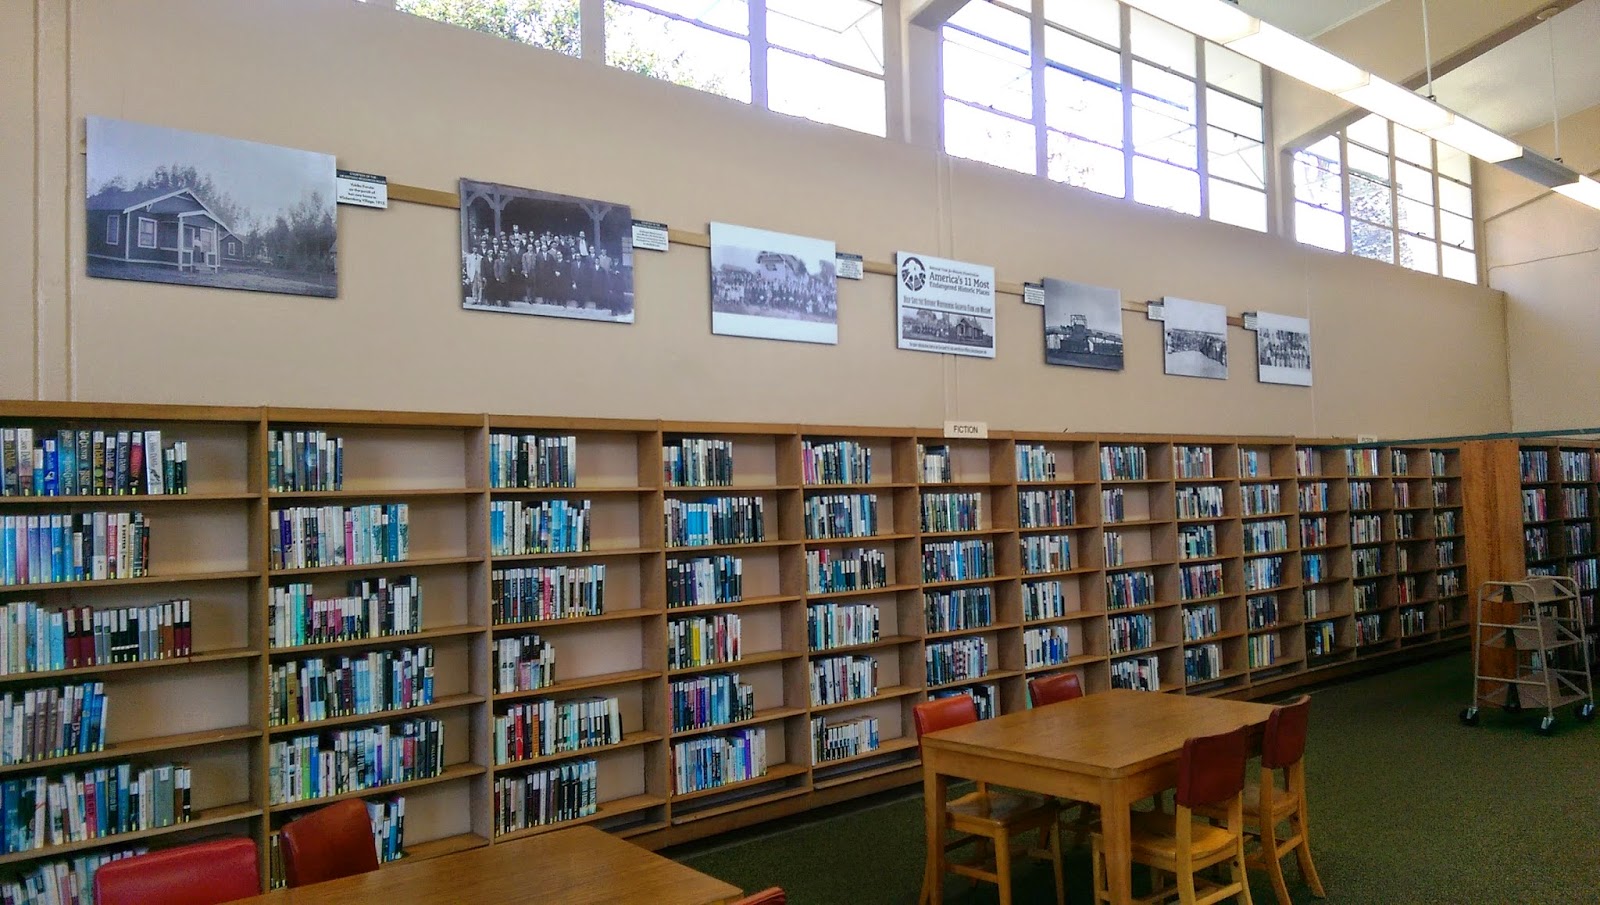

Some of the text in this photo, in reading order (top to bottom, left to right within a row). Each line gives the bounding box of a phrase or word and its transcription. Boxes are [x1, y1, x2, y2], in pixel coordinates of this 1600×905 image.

[929, 271, 963, 285] America's
[964, 277, 972, 287] 11
[973, 278, 990, 290] Most
[953, 425, 979, 434] FICTION
